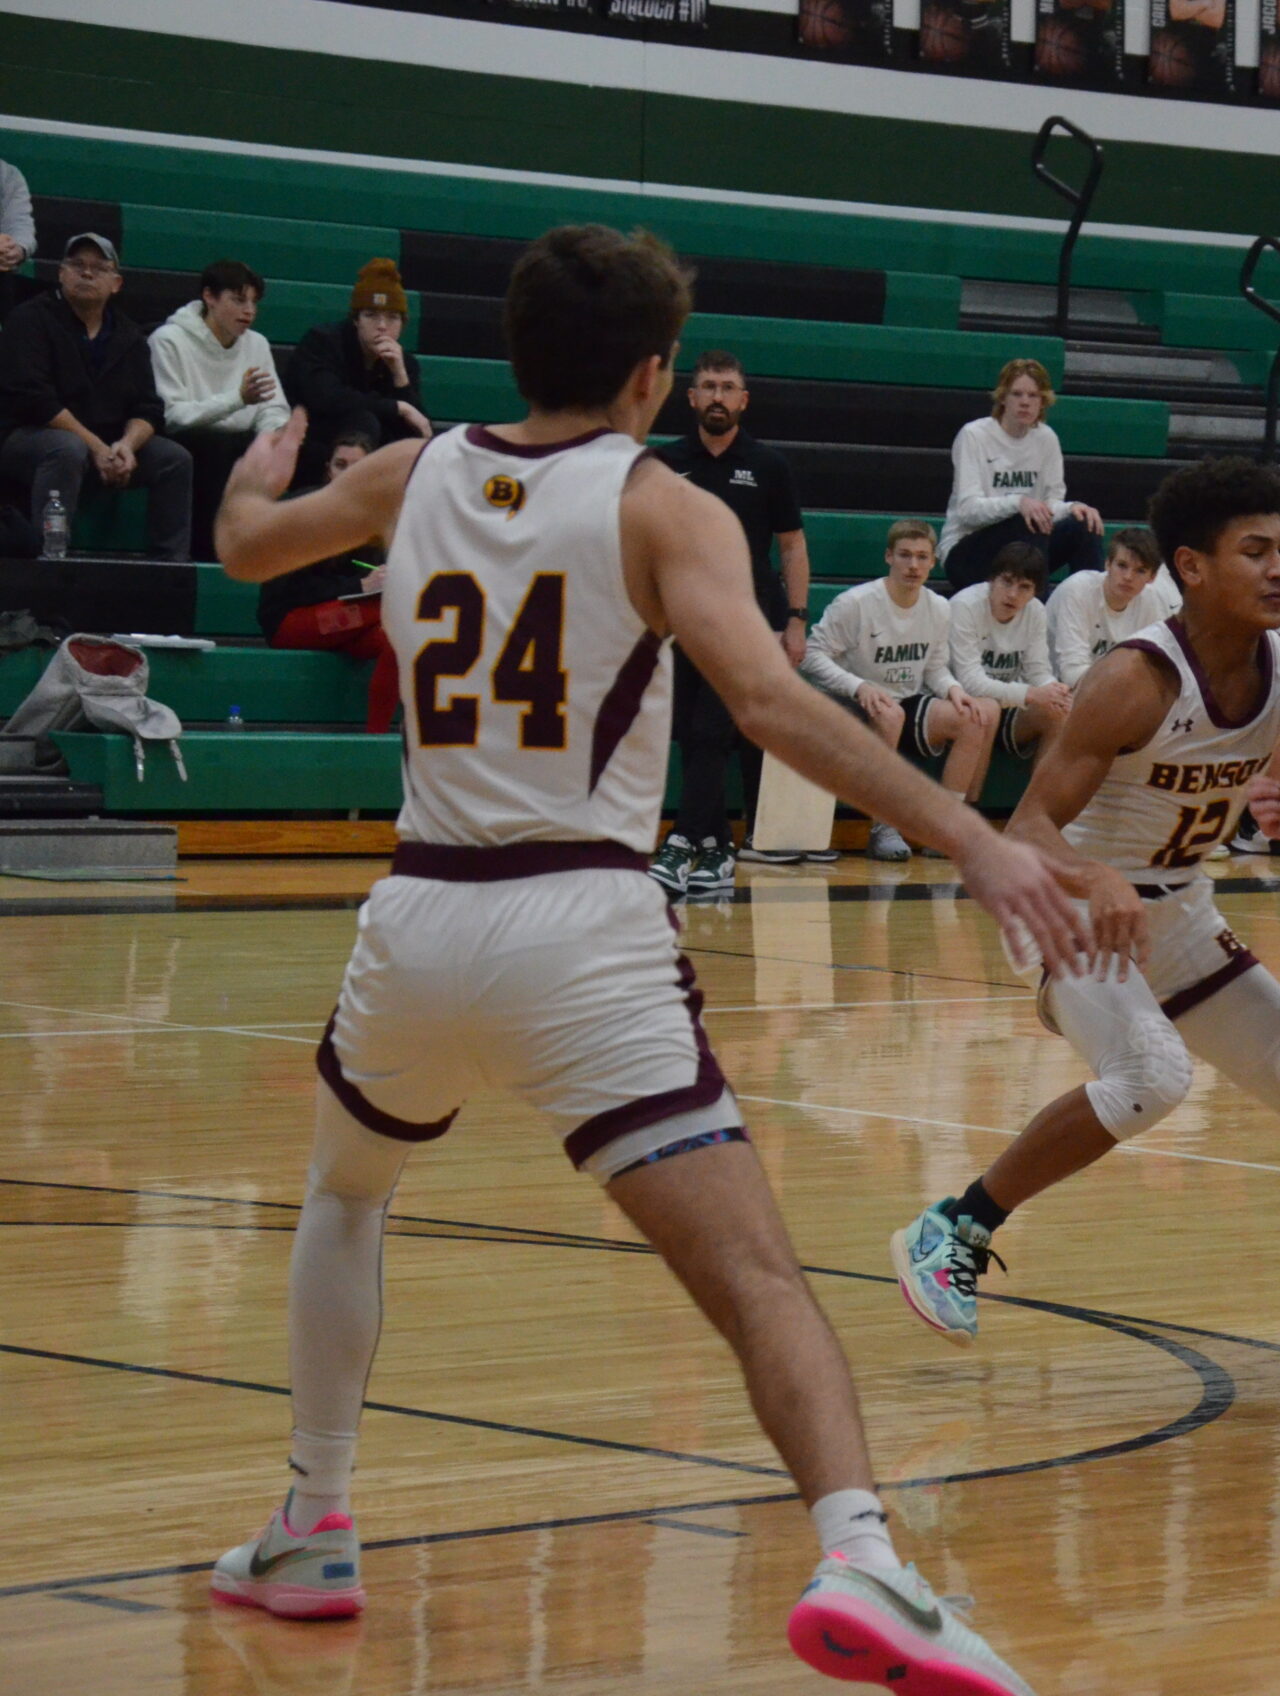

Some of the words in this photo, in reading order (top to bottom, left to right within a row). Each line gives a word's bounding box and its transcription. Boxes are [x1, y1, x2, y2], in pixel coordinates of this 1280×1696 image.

[414, 571, 569, 750] 24
[874, 642, 930, 664] FAMILY
[1148, 797, 1232, 869] 12
